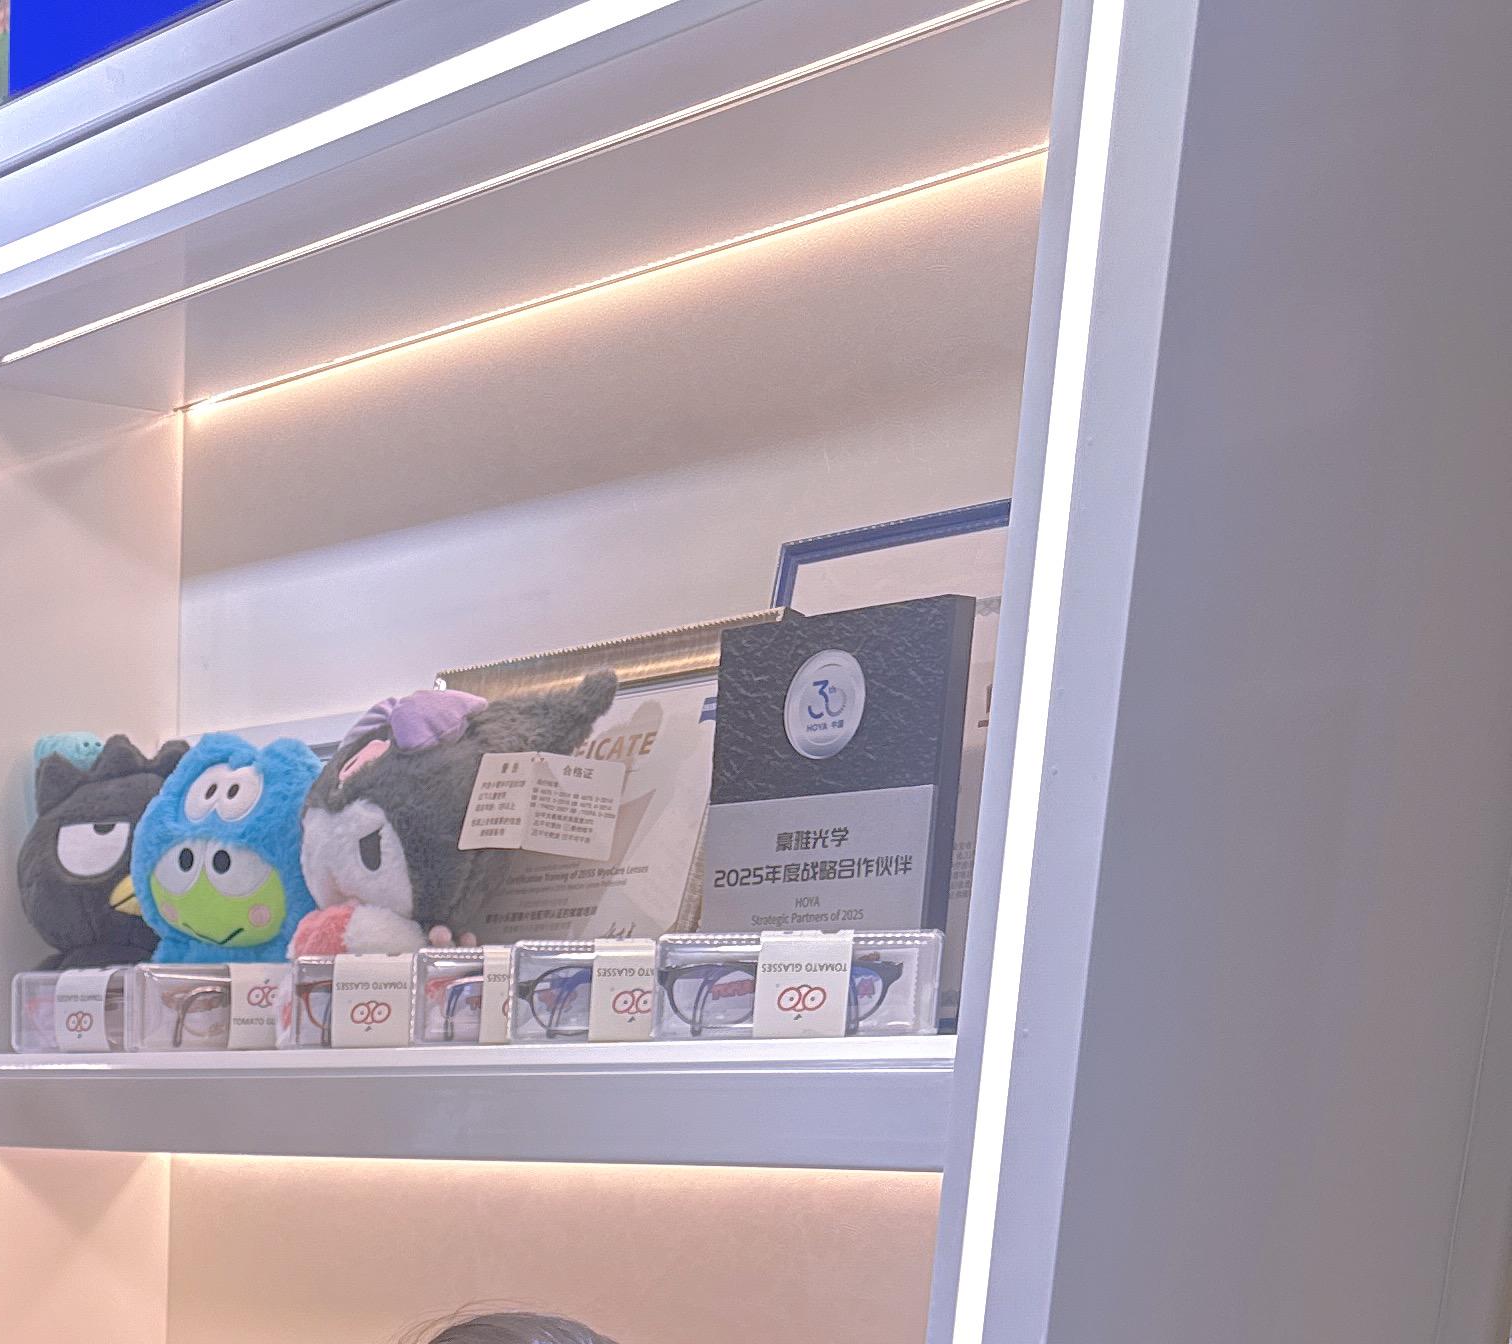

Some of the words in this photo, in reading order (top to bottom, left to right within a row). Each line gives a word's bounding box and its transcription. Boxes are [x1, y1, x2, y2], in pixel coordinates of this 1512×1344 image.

[806, 722, 827, 732] HOYA
[563, 764, 594, 780] 合格证
[775, 827, 849, 852] 豪雅光学
[713, 854, 913, 888] 2025年度战略合作伙伴
[794, 896, 820, 908] HOYA
[751, 914, 790, 926] Strategic
[791, 911, 829, 924] Partners
[830, 910, 840, 922] of
[841, 908, 864, 921] 2025
[596, 967, 635, 977] GLASSES
[761, 963, 803, 973] GLASSES
[804, 962, 848, 972] TOMATO
[336, 981, 370, 991] GLASSES
[372, 981, 408, 990] TOMATO
[232, 1017, 265, 1026] TOMATO
